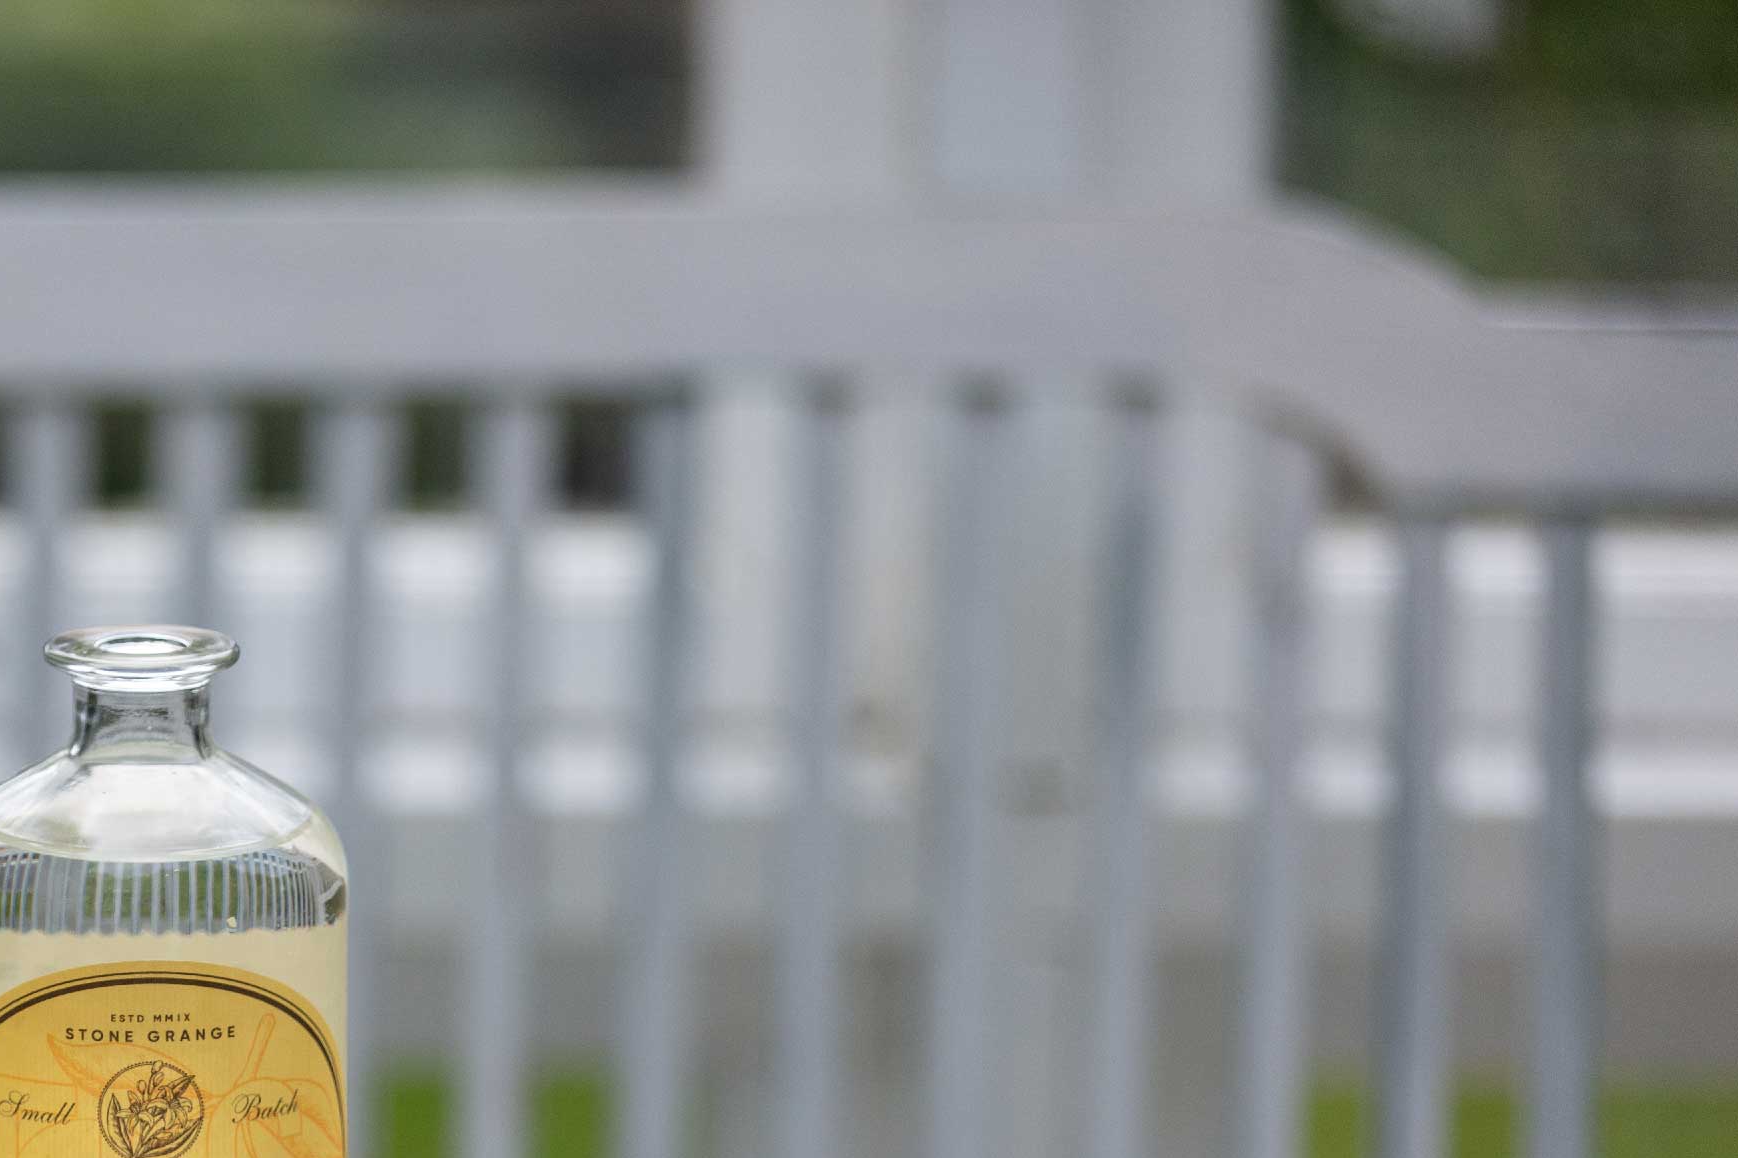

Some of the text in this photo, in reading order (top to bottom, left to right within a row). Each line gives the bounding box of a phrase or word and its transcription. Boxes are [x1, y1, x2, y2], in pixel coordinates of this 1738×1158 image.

[110, 1012, 191, 1024] ESTD MMIX
[65, 1025, 236, 1043] STONE GRANGE
[232, 1088, 300, 1124] Batch
